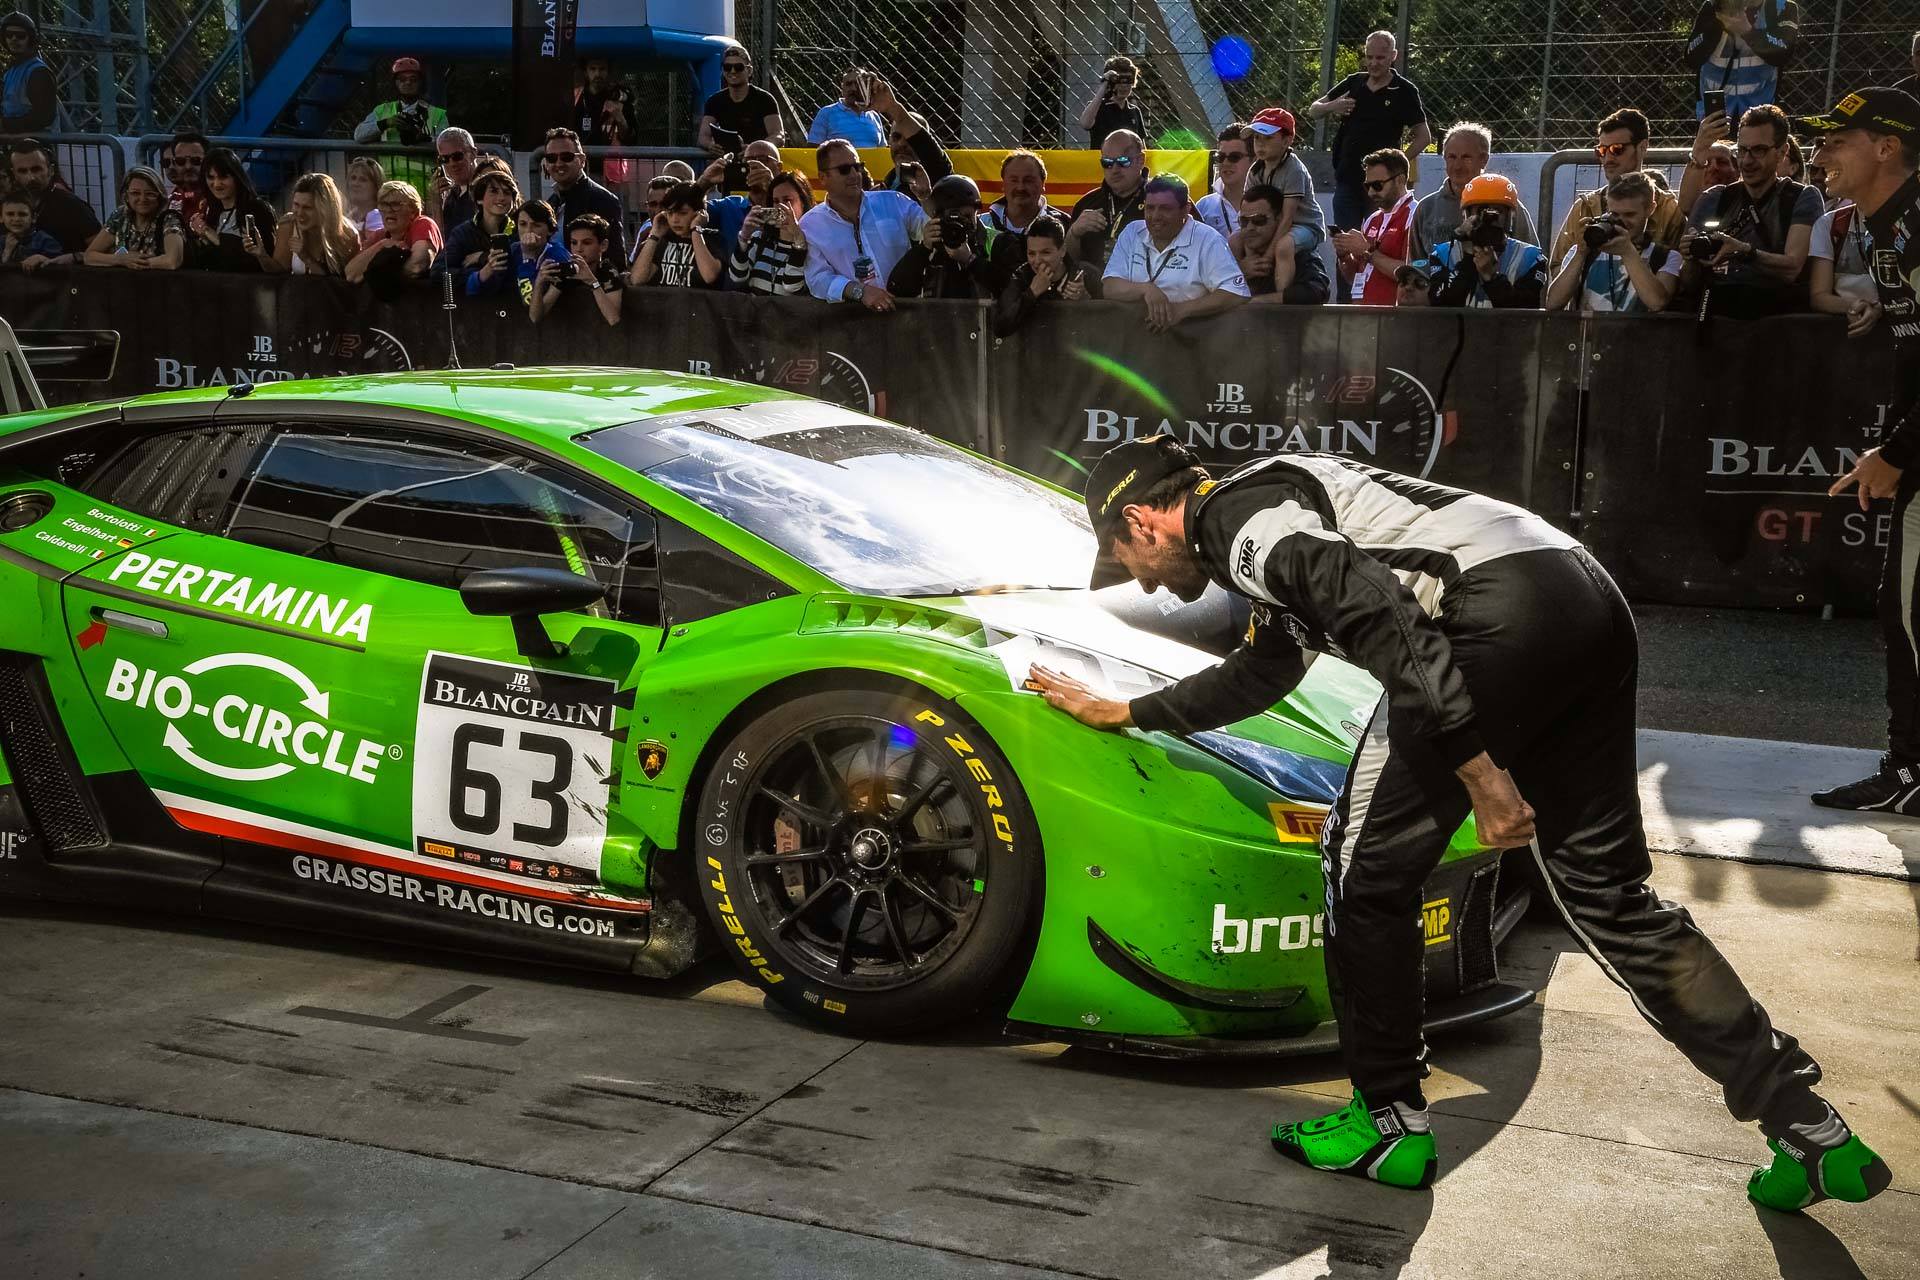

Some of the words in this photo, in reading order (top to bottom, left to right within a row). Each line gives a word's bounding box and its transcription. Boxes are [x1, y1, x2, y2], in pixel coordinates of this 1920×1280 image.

[541, 0, 556, 57] BLAN
[247, 352, 277, 363] 1735
[1206, 402, 1253, 415] 1735
[1083, 408, 1383, 457] BLANCPAIN
[1861, 426, 1882, 438] 17
[1706, 437, 1861, 478] BLAN
[1106, 470, 1137, 505] ZERO
[62, 518, 118, 544] Engelhart
[86, 508, 143, 533] Bortolotti
[1757, 507, 1823, 543] GT
[1841, 512, 1893, 547] SE
[35, 531, 87, 555] Caldarelli
[1240, 539, 1254, 579] OMP
[109, 551, 374, 643] PERTAMINA
[432, 678, 604, 728] BLANCPAIN
[505, 683, 532, 694] 1735
[449, 722, 574, 848] 63
[914, 709, 945, 727] P
[944, 732, 1013, 844] ZERO
[1899, 768, 1912, 784] OMP
[292, 855, 616, 938] GRASSER-RACING.COM
[707, 856, 785, 984] PIRELLI
[1423, 906, 1450, 936] MP
[1777, 1138, 1804, 1161] OMP
